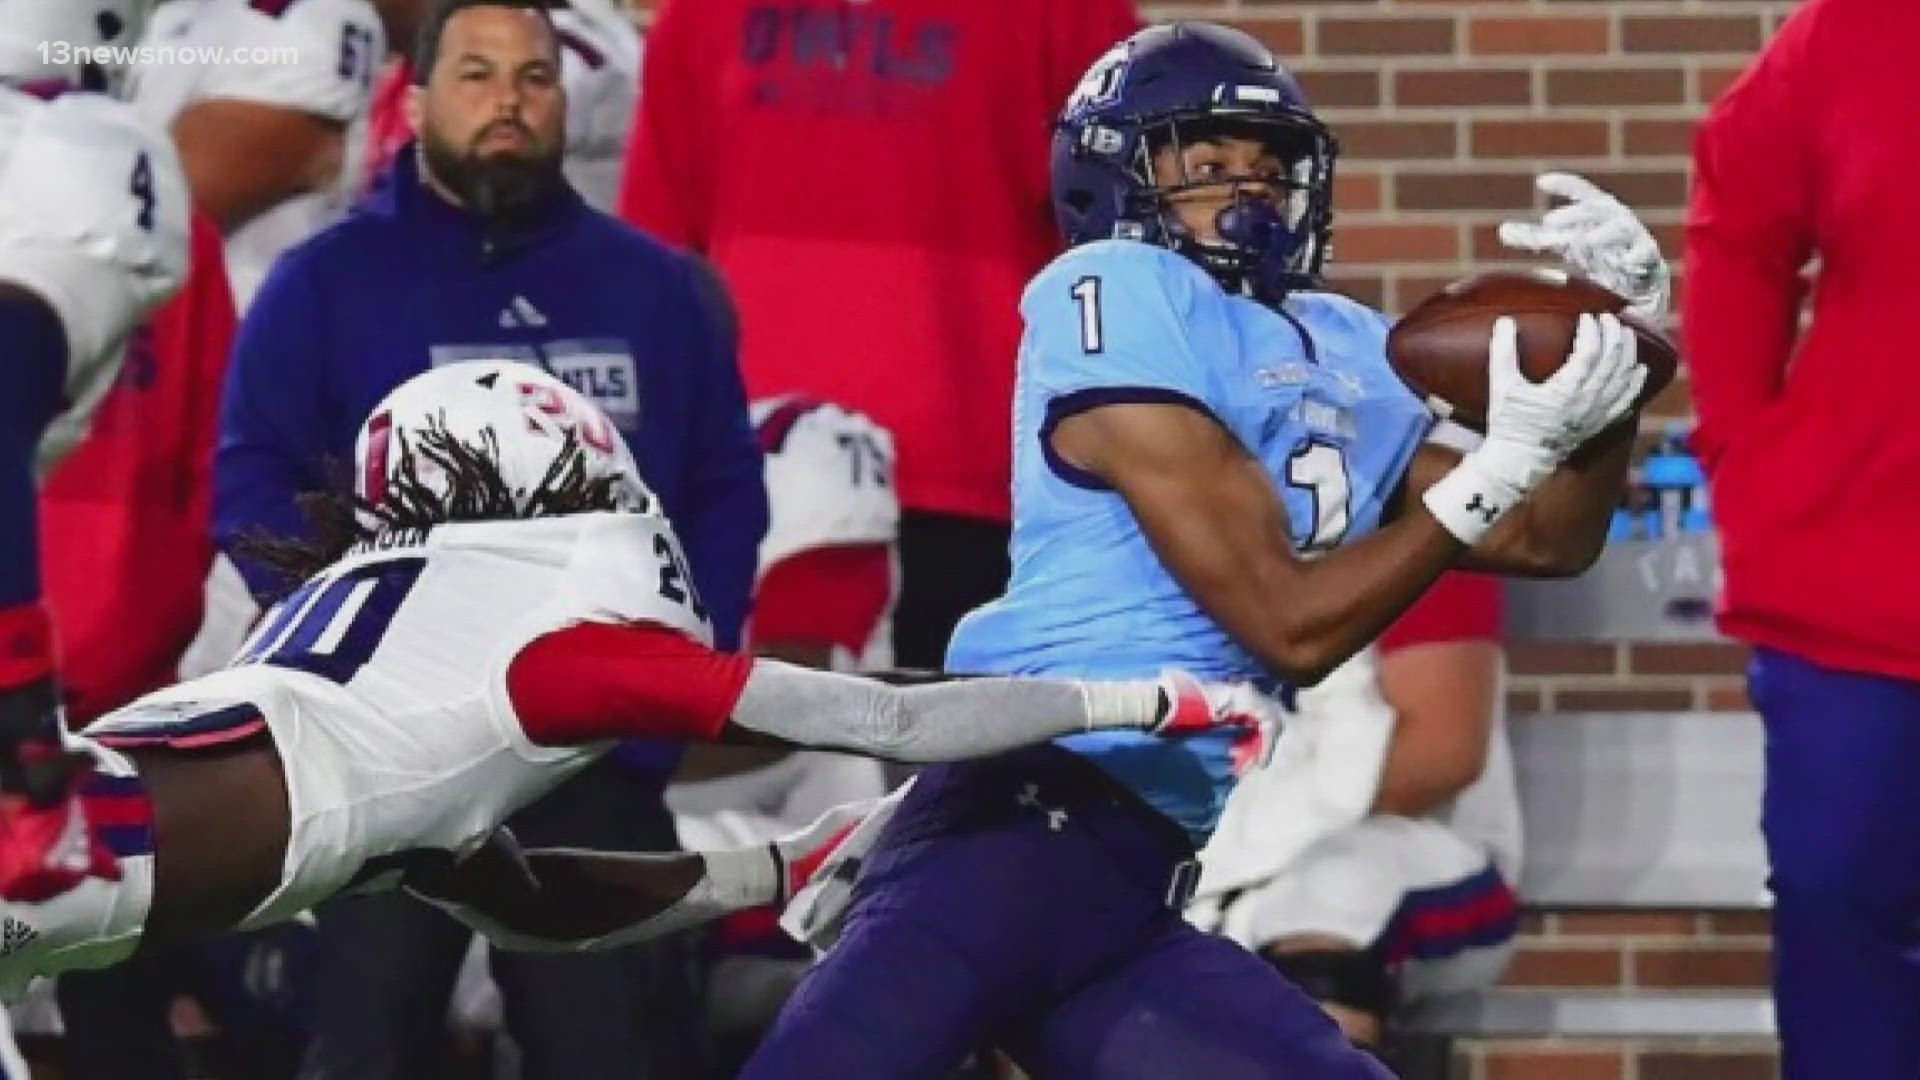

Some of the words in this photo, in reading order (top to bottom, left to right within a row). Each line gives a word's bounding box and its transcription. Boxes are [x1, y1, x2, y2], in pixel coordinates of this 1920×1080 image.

[741, 7, 960, 84] OWLS
[130, 151, 157, 231] 4
[1070, 275, 1103, 355] 1
[556, 366, 626, 398] WLS
[1284, 438, 1352, 556] 1
